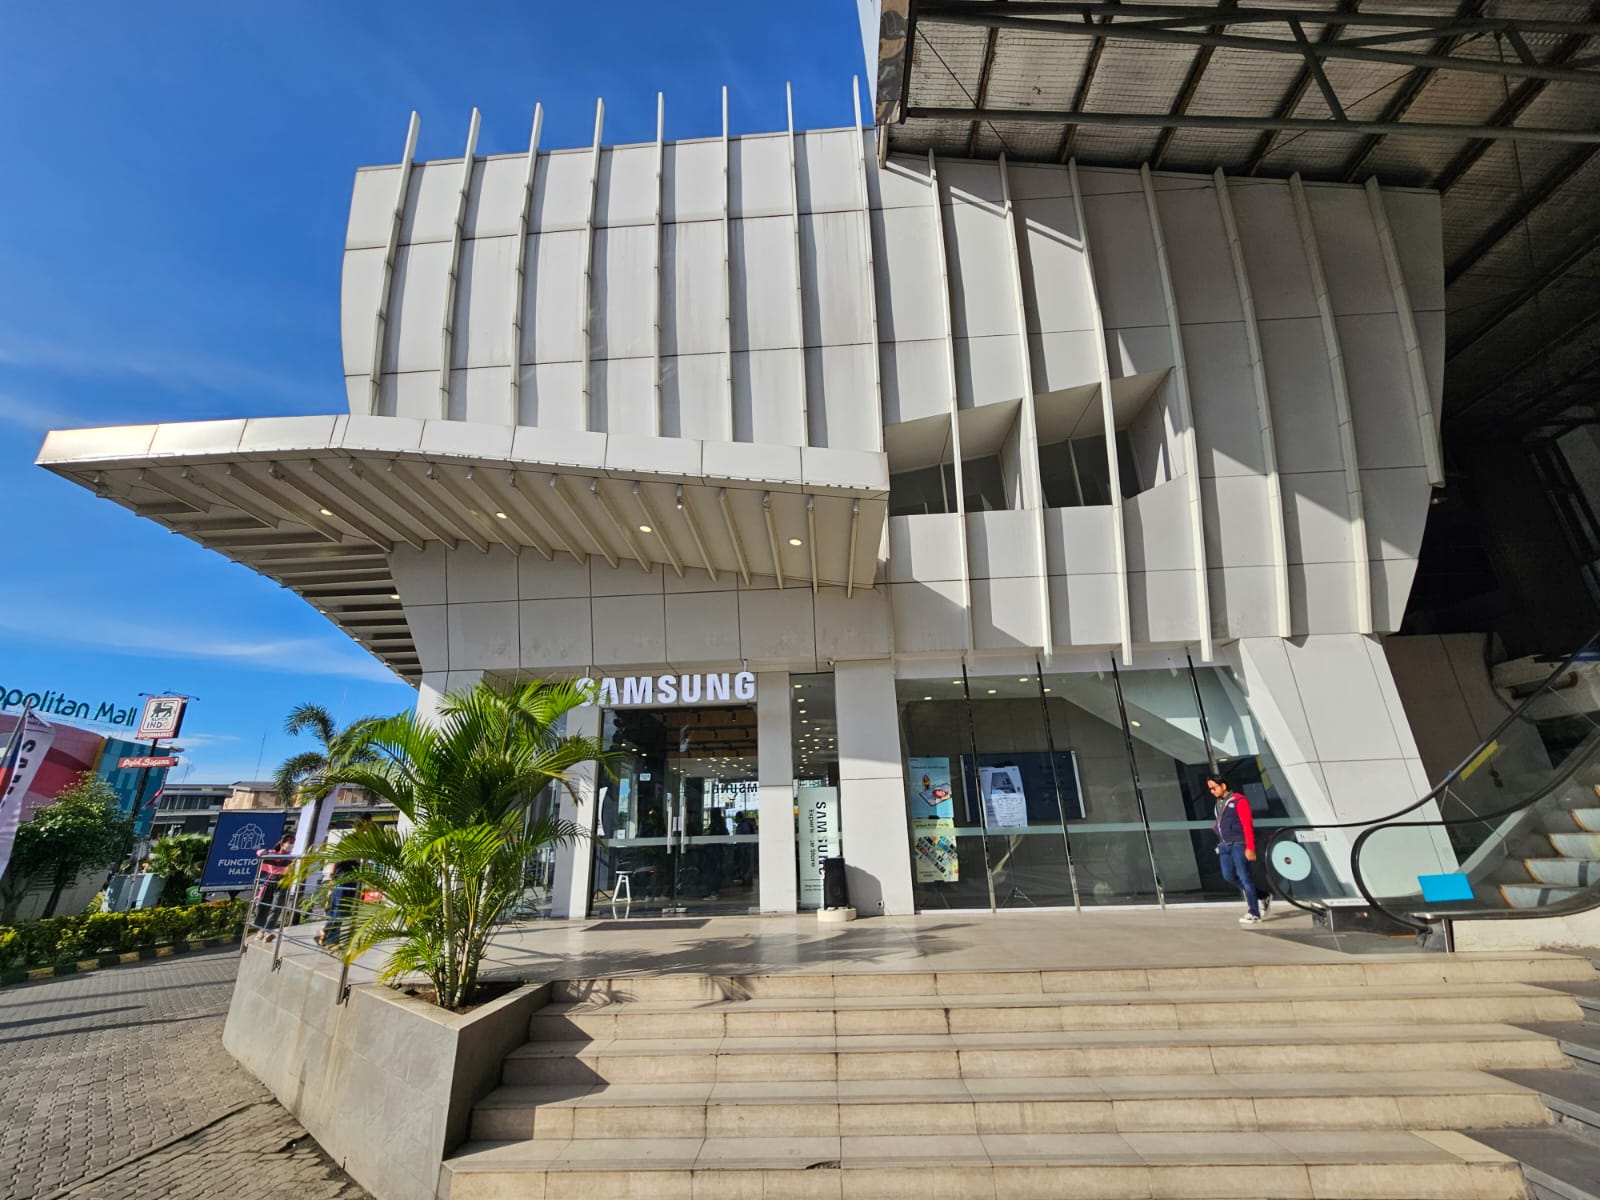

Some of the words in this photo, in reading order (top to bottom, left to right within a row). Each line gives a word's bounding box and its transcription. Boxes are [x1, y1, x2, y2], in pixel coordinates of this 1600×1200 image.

[576, 671, 755, 707] SAMSUNG
[94, 701, 138, 727] Mall
[217, 858, 259, 867] FUNCTIO
[228, 867, 251, 875] HALL
